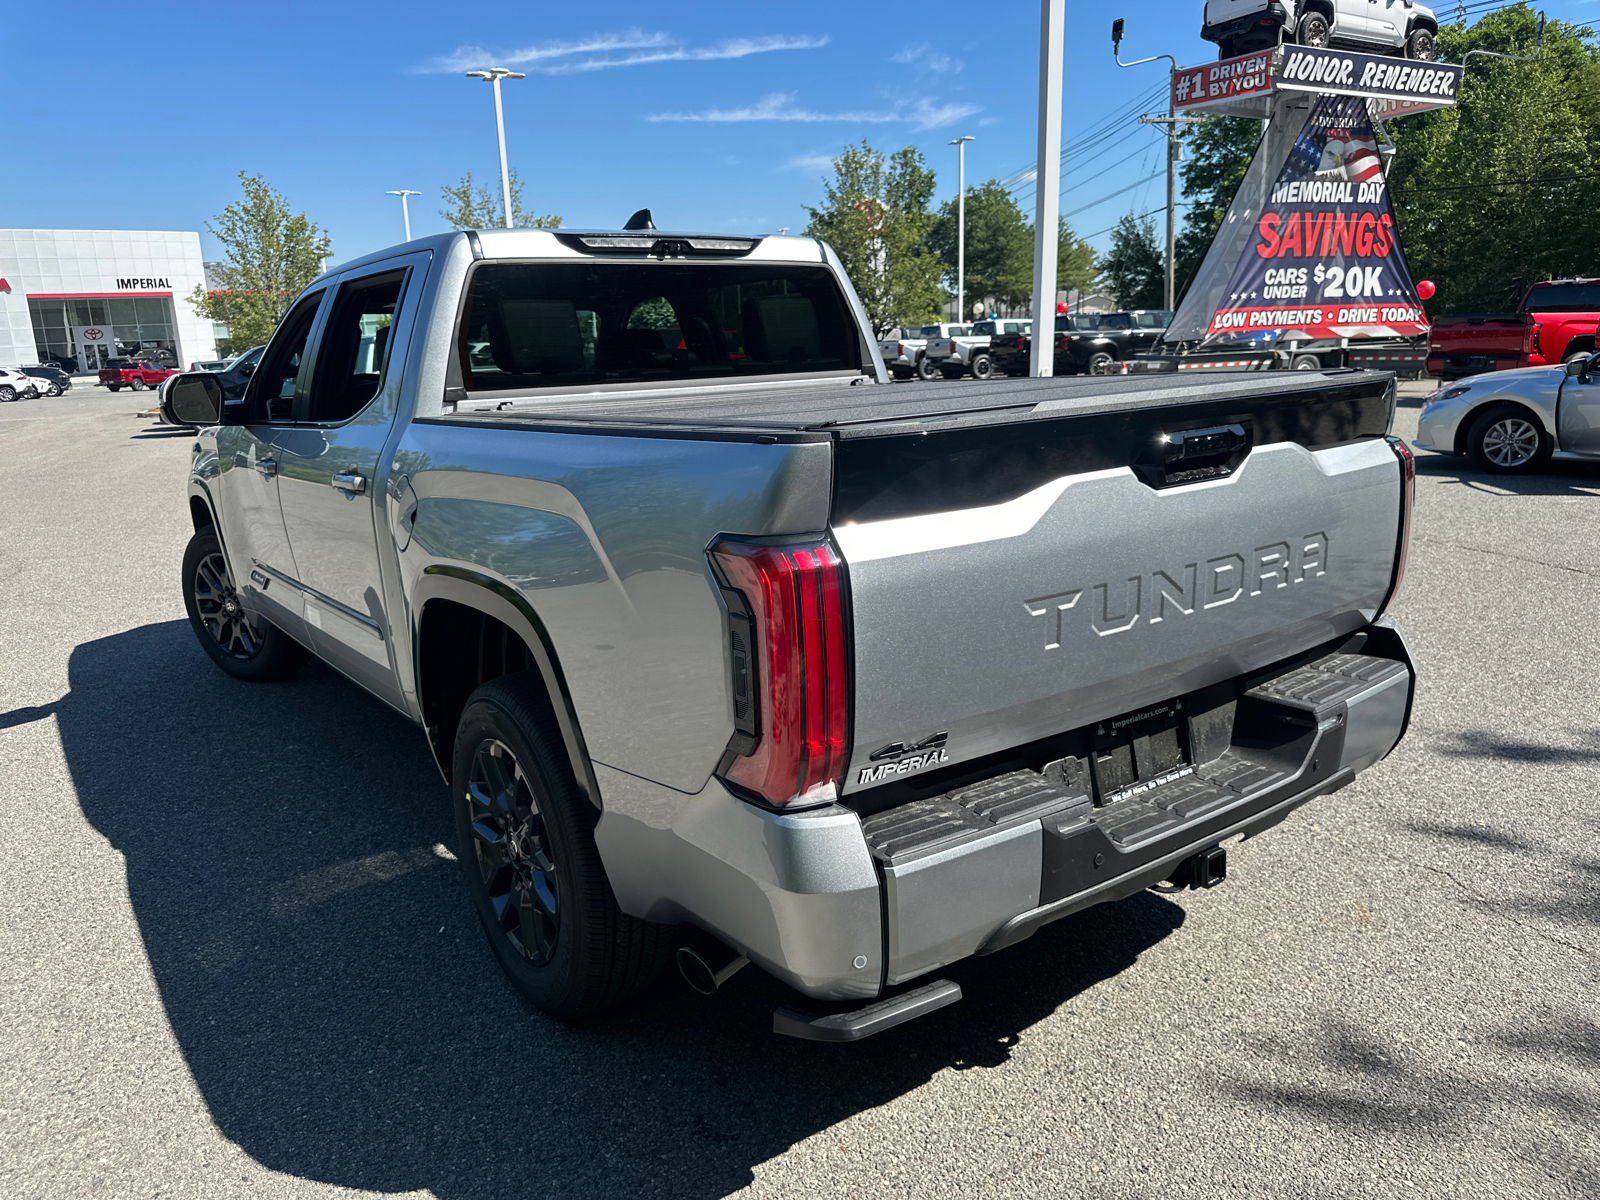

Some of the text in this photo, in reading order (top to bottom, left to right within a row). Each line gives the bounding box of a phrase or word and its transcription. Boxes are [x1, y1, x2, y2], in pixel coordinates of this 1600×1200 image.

[1209, 56, 1267, 82] DRIVEN
[1283, 52, 1455, 96] HONOR. REMEMBER.
[1175, 71, 1206, 102] #1
[1209, 72, 1266, 97] BY YOU
[1271, 182, 1353, 204] MEMORIAL
[1356, 182, 1386, 204] DAY
[1256, 212, 1394, 259] SAVINGS
[116, 277, 172, 290] IMPERIAL
[1264, 268, 1308, 285] CARS
[1312, 263, 1384, 298] $20K
[1263, 285, 1308, 300] UNDER
[1214, 312, 1247, 329] LOW
[1249, 309, 1323, 327] PAYMENTS
[1337, 308, 1380, 324] DRIVE
[1381, 307, 1422, 322] TODAY
[1023, 531, 1329, 651] TUNDRA
[1111, 706, 1169, 729] Imperialcars.com
[858, 748, 949, 785] IMPERIAL
[1148, 780, 1156, 789] So
[1156, 777, 1166, 786] You
